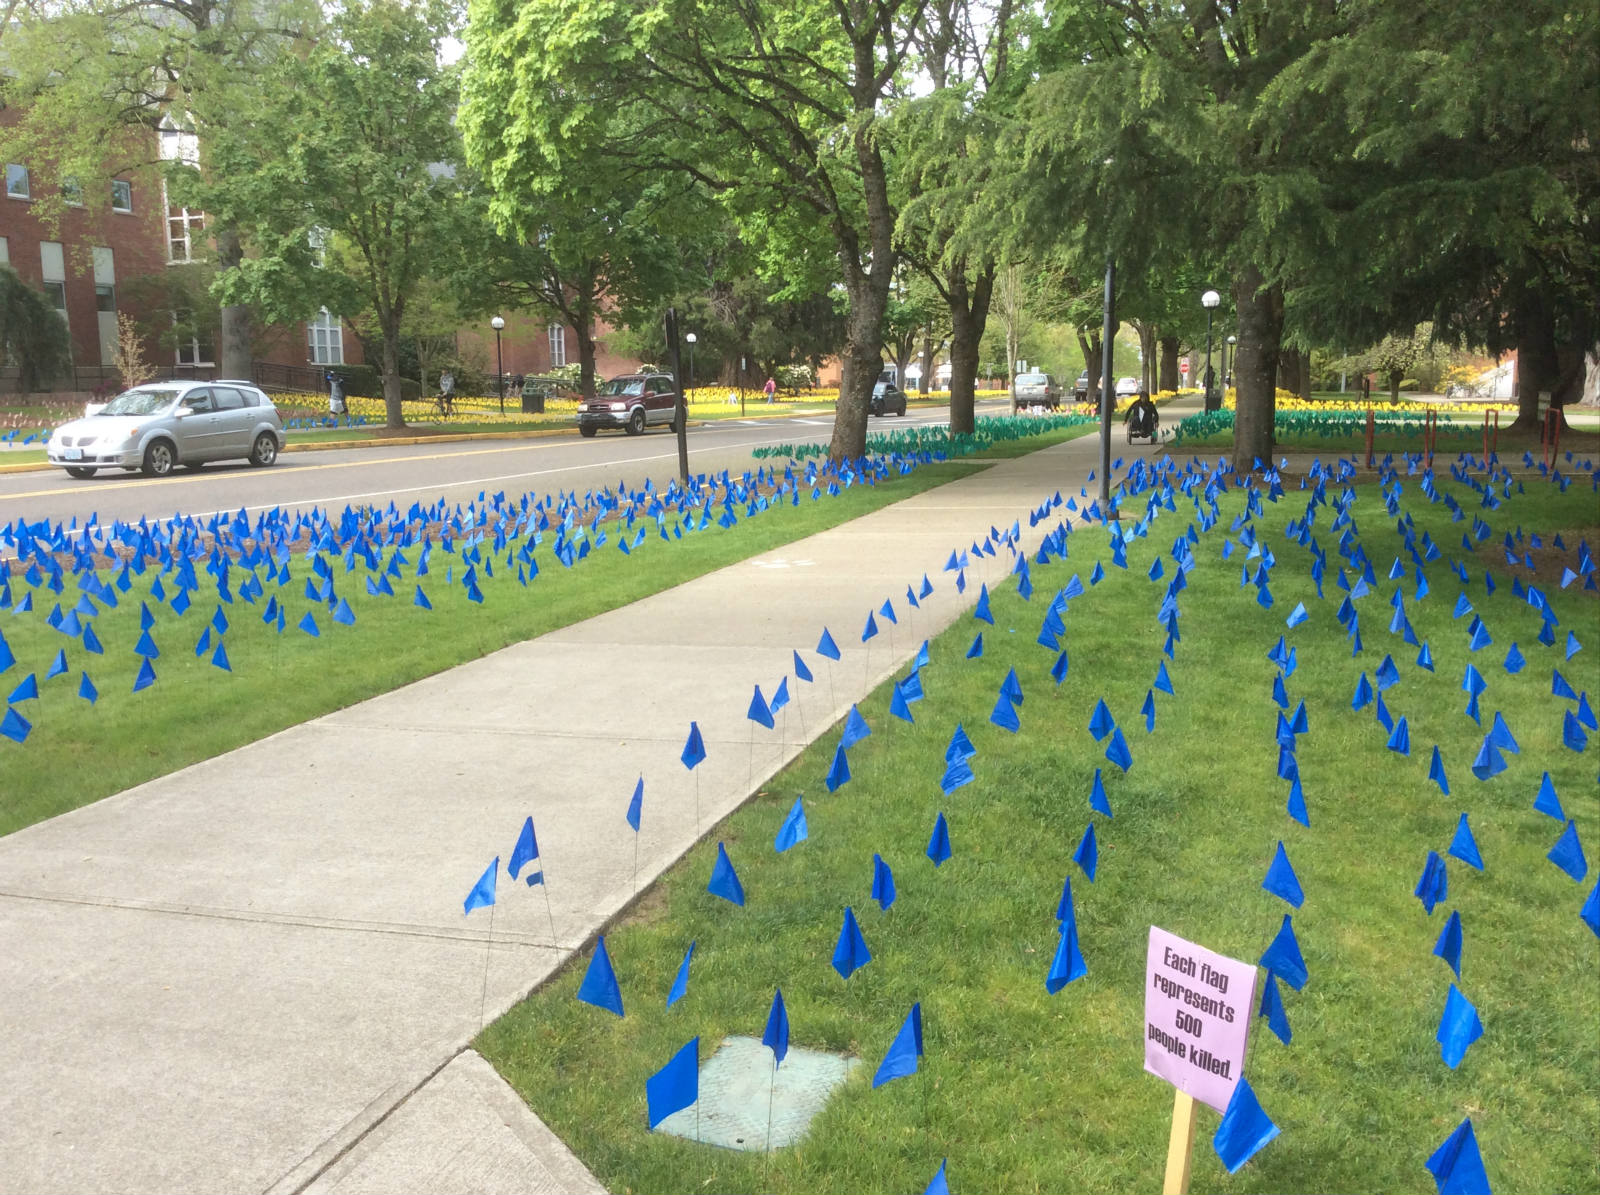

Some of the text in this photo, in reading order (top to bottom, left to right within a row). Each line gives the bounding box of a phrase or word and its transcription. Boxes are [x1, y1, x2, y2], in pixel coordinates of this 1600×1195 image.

[1163, 946, 1229, 994] Each flag
[1153, 973, 1235, 1023] represents
[1175, 1009, 1203, 1038] 500
[1148, 1022, 1233, 1081] people killed.
